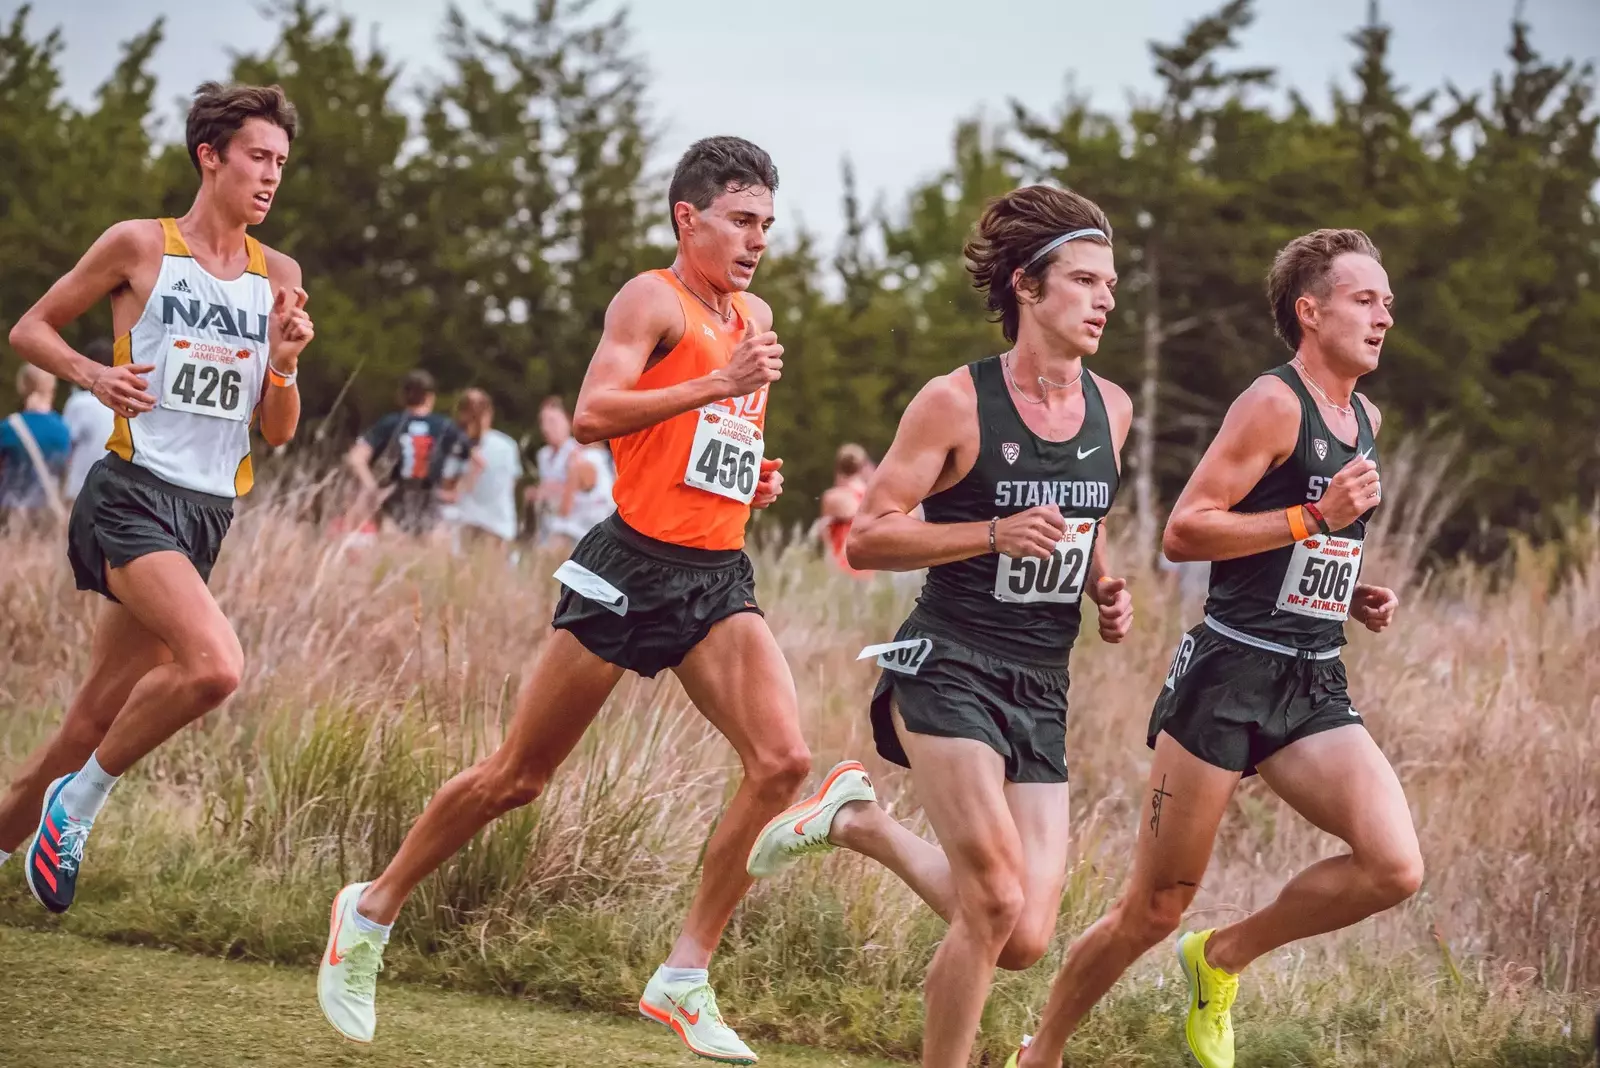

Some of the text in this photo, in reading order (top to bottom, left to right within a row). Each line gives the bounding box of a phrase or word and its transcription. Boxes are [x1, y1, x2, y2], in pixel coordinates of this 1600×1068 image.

[161, 295, 268, 344] NAU
[189, 351, 236, 365] JAMBOREE
[194, 342, 233, 356] COWBOY
[171, 363, 242, 411] 426
[717, 427, 753, 446] JAMBOREE
[722, 418, 752, 435] COWBOY
[695, 438, 756, 495] 456
[995, 480, 1109, 509] STANFORD
[1008, 548, 1084, 595] 502
[1298, 556, 1353, 602] 506
[1287, 594, 1309, 606] M-F
[1311, 599, 1347, 613] ATHLETIC
